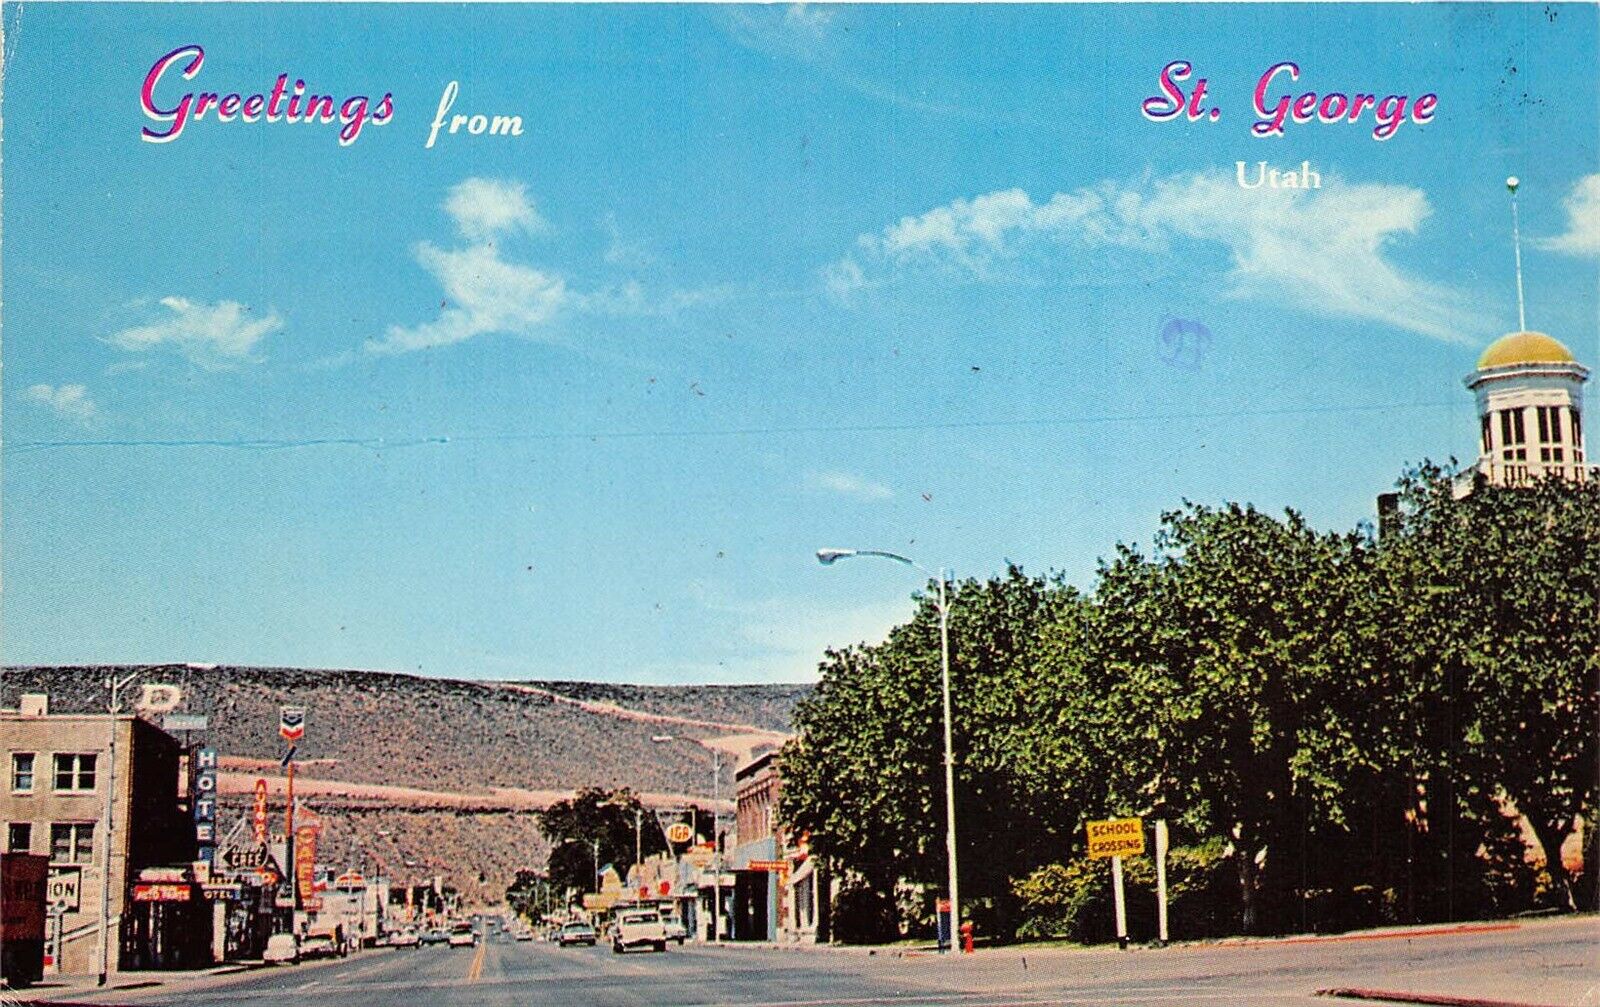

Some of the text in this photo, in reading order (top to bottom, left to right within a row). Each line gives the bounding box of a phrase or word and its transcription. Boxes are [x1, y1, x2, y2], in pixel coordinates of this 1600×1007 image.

[670, 825, 690, 840] IGA
[1092, 823, 1138, 837] SCHOOL
[1091, 838, 1141, 853] CROSSING
[231, 853, 263, 867] CAFE
